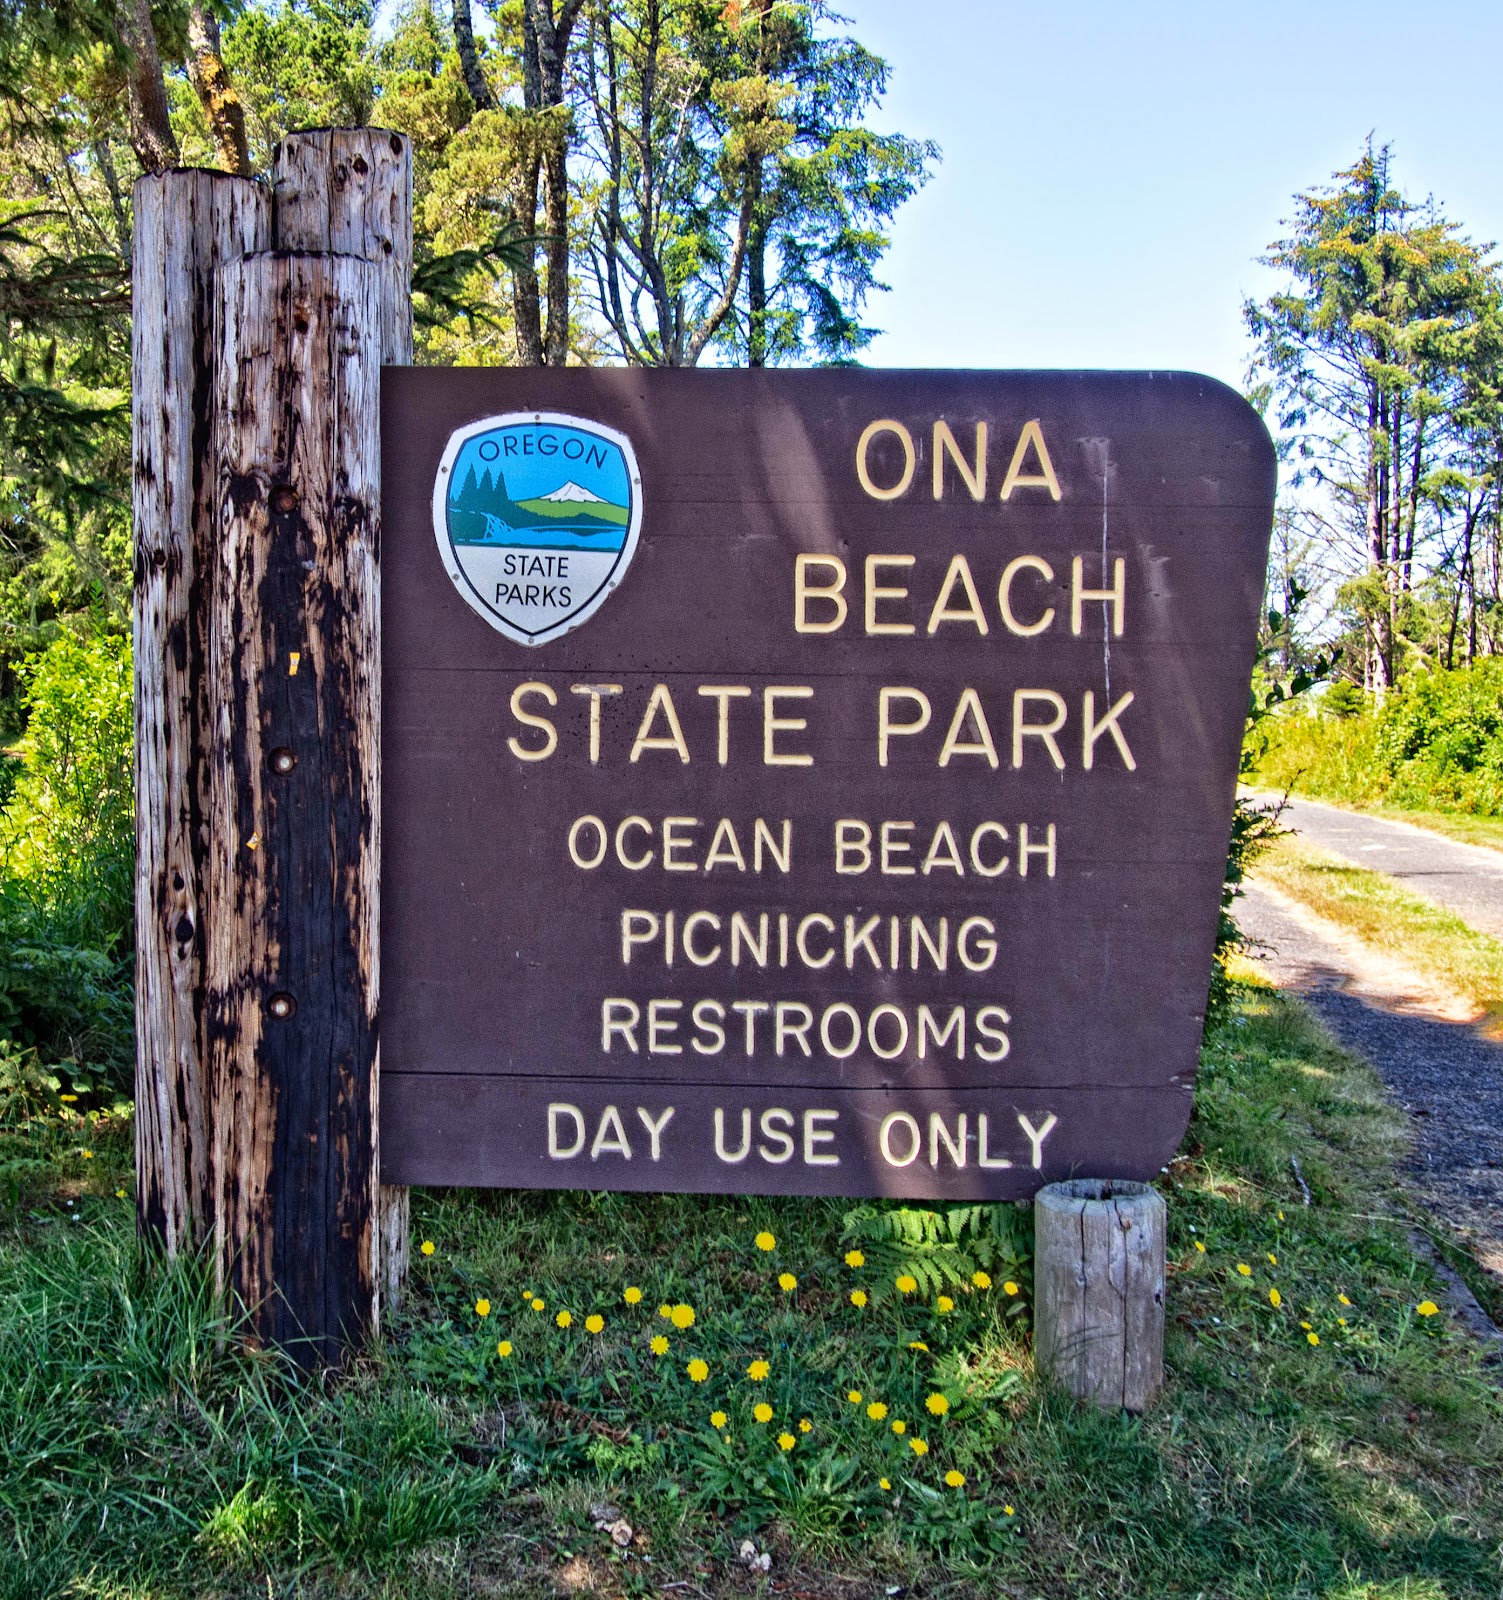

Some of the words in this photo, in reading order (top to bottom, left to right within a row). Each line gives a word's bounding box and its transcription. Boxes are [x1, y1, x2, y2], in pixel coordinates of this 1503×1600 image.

[478, 434, 608, 469] OREGON
[856, 419, 1063, 502] ONA
[495, 583, 572, 608] PARKS
[503, 554, 569, 578] STATE
[794, 553, 1125, 637] BEACH
[508, 682, 814, 766] STATE
[878, 686, 1137, 771] PARK
[568, 815, 791, 873] OCEAN
[835, 819, 1056, 878] BEACH
[621, 909, 998, 972] PICNICKING
[601, 998, 1011, 1062] RESTROOMS
[548, 1103, 675, 1161] DAY
[714, 1108, 840, 1165] USE
[879, 1111, 1058, 1170] ONLY
